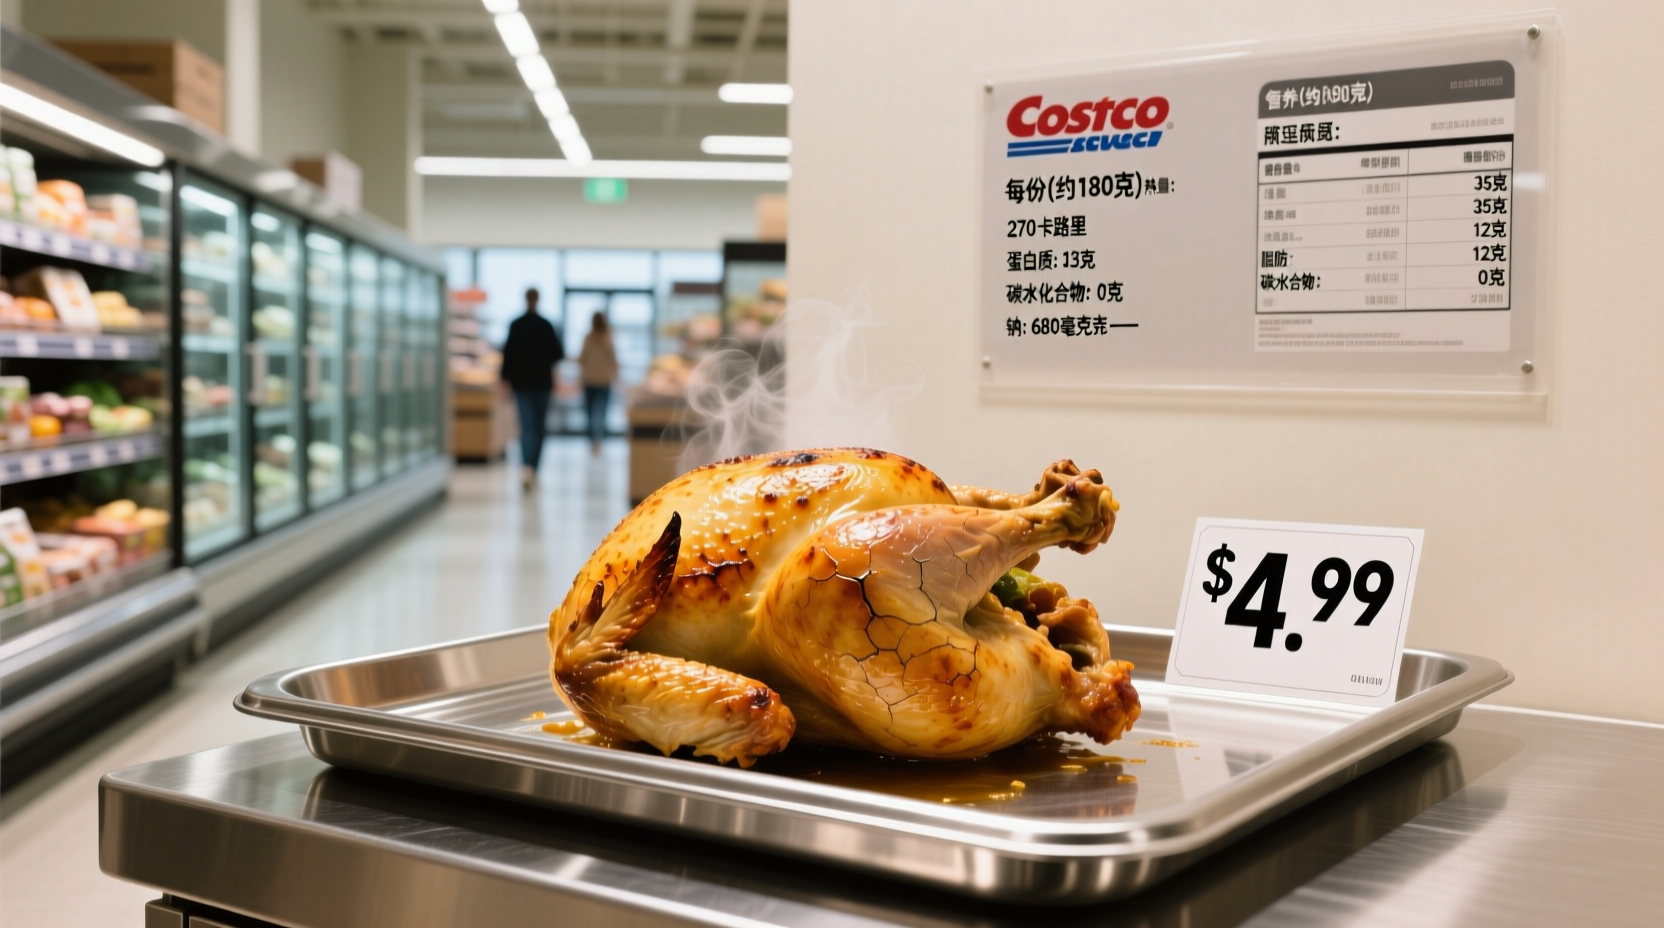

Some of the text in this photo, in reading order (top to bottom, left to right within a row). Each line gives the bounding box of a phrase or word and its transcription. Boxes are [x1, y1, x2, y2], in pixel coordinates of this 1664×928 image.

[1006, 95, 1170, 138] Costco
[1474, 171, 1508, 192] 35克
[1473, 195, 1508, 215] 35克
[1473, 218, 1507, 238] 12克
[1472, 243, 1507, 262] 12克
[1478, 266, 1505, 287] 0克
[1202, 543, 1395, 653] $4.99
